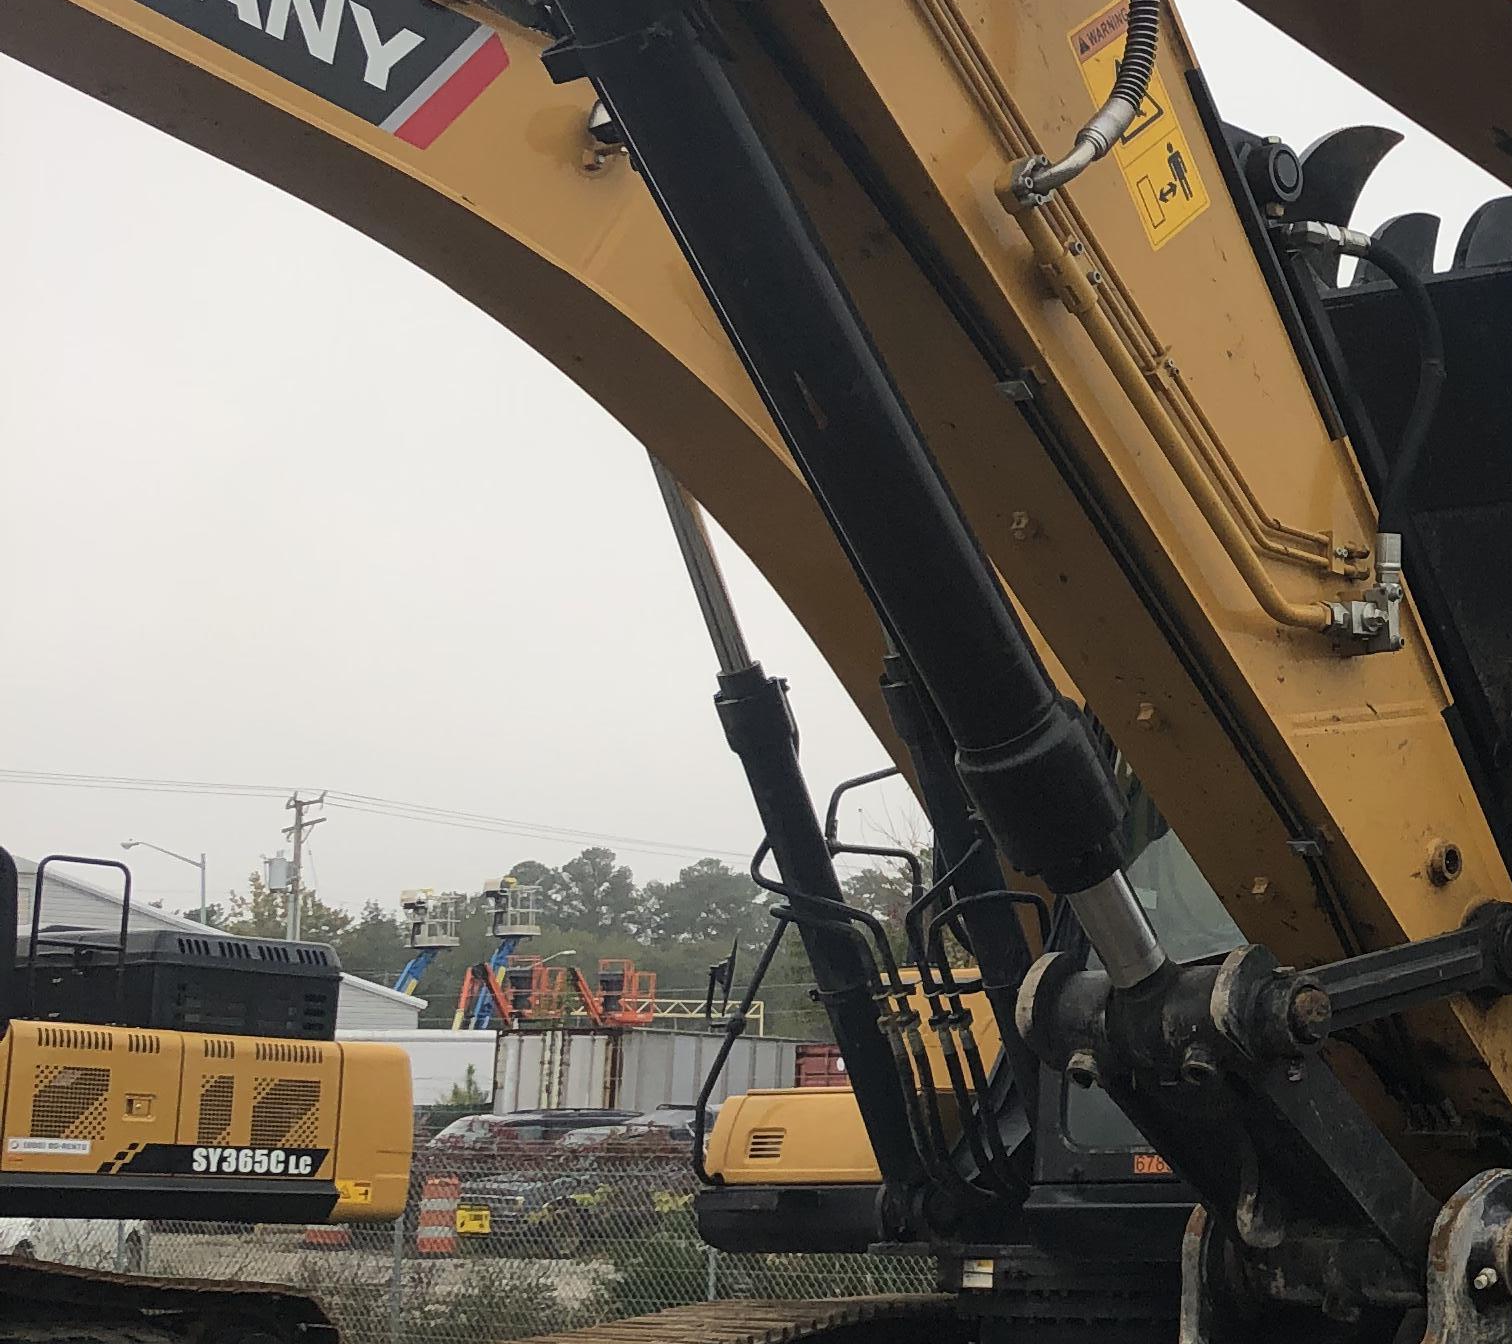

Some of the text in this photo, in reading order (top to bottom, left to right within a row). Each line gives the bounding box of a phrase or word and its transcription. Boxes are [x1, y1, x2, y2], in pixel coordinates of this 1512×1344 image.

[1087, 7, 1129, 46] WARNING
[192, 1147, 313, 1175] SY365C LC
